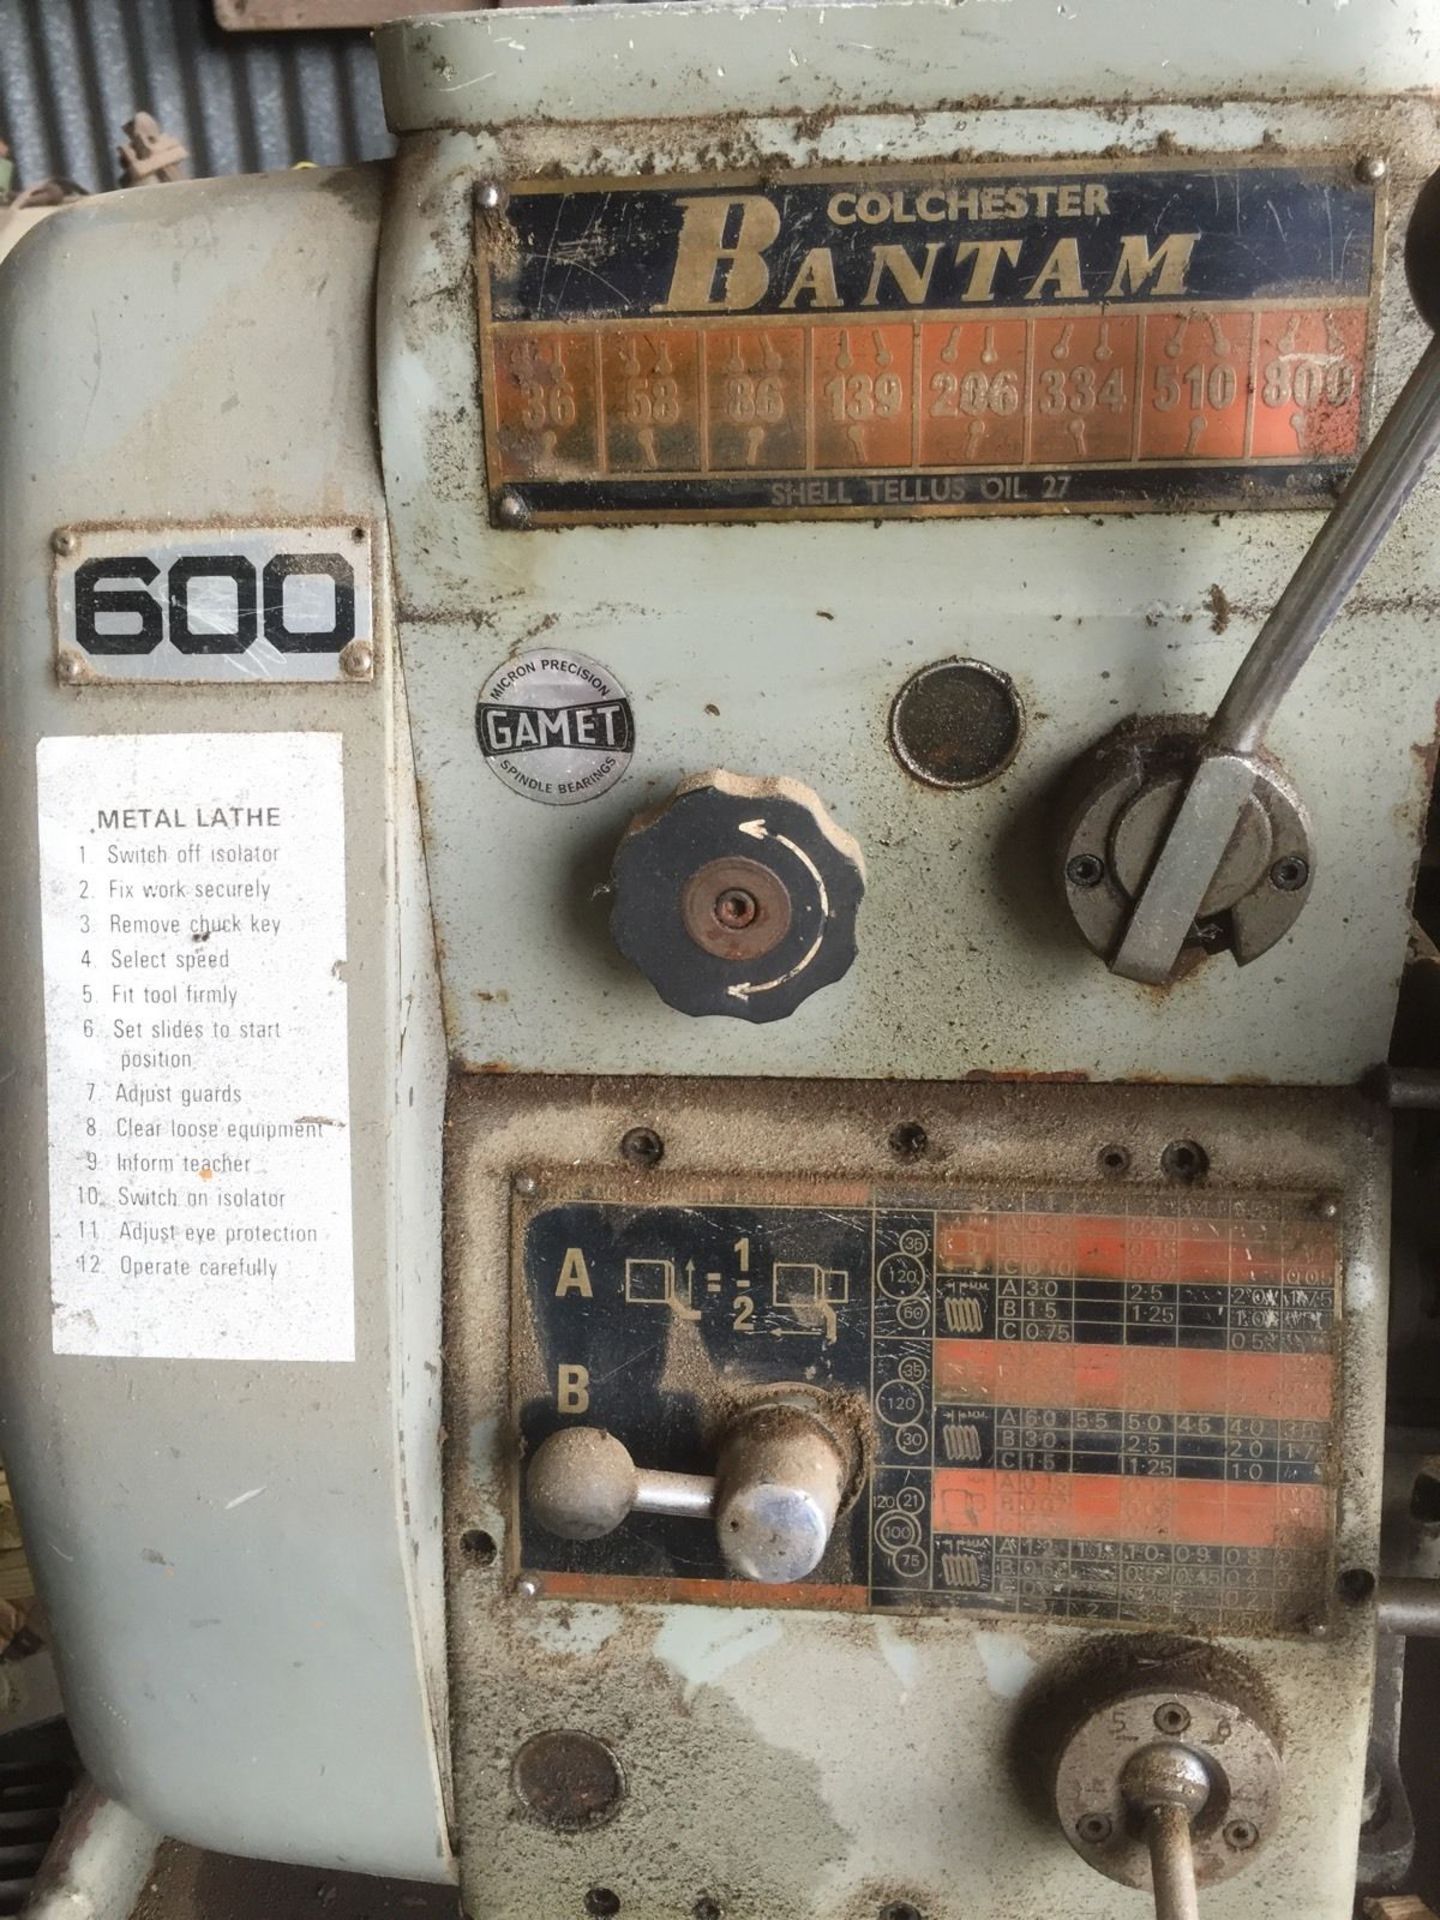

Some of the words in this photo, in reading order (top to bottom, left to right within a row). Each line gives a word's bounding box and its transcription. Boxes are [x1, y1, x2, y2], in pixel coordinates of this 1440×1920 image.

[827, 184, 1110, 225] COLCHESTER
[521, 381, 576, 428] 36
[625, 377, 680, 425] 58
[725, 374, 785, 424] 86
[824, 371, 903, 421] 139
[1039, 365, 1127, 414] 334
[1153, 363, 1237, 412] 510
[771, 481, 852, 506] SHELL
[867, 477, 966, 505] TELLUS
[980, 476, 1027, 500] OIL
[1041, 475, 1072, 499] 27
[75, 553, 355, 655] 600
[490, 661, 537, 701] MICRON
[541, 659, 610, 697] PRECISION
[486, 706, 620, 750] GAMET
[500, 759, 552, 793] SPINDLE
[558, 756, 616, 794] BEARINGS
[98, 809, 185, 829] METAL
[197, 807, 280, 827] LATHE
[108, 845, 167, 864] Switch
[177, 844, 201, 863] off
[211, 845, 278, 862] isolator
[110, 880, 134, 898] Fix
[143, 880, 185, 898] work
[195, 879, 270, 901] securely
[111, 915, 180, 933] Remove
[190, 915, 242, 933] chuck
[251, 914, 280, 935] key
[112, 949, 166, 968] Select
[176, 949, 229, 971] speed
[113, 985, 133, 1003] Fit
[144, 985, 176, 1003] tool
[187, 985, 237, 1006] firmly
[114, 1019, 141, 1038] Set
[152, 1020, 203, 1038] slides
[213, 1021, 230, 1038] to
[240, 1021, 280, 1038] start
[121, 1051, 191, 1071] position
[116, 1083, 171, 1106] Adjust
[181, 1084, 242, 1107] guards
[117, 1118, 161, 1137] Clear
[172, 1119, 218, 1137] loose
[228, 1121, 323, 1141] equipment
[118, 1153, 174, 1172] Inform
[184, 1154, 250, 1172] teacher
[118, 1187, 177, 1206] Switch
[188, 1192, 208, 1206] on
[218, 1188, 285, 1206] isolator
[120, 1222, 175, 1244] Adjust
[185, 1226, 215, 1245] eye
[226, 1223, 317, 1246] protection
[121, 1256, 190, 1276] Operate
[200, 1257, 276, 1280] carefully
[555, 1248, 593, 1298] A
[889, 1265, 917, 1283] 120
[1002, 1279, 1017, 1295] A
[1003, 1300, 1016, 1317] B
[1002, 1322, 1017, 1339] C
[558, 1364, 590, 1414] B
[887, 1396, 916, 1411] 120
[1001, 1408, 1016, 1425] A
[903, 1433, 922, 1447] 30
[1003, 1430, 1015, 1447] B
[1001, 1452, 1015, 1468] C
[873, 1494, 895, 1508] 120
[903, 1493, 918, 1508] 21
[885, 1525, 911, 1540] 100
[902, 1553, 921, 1567] 75
